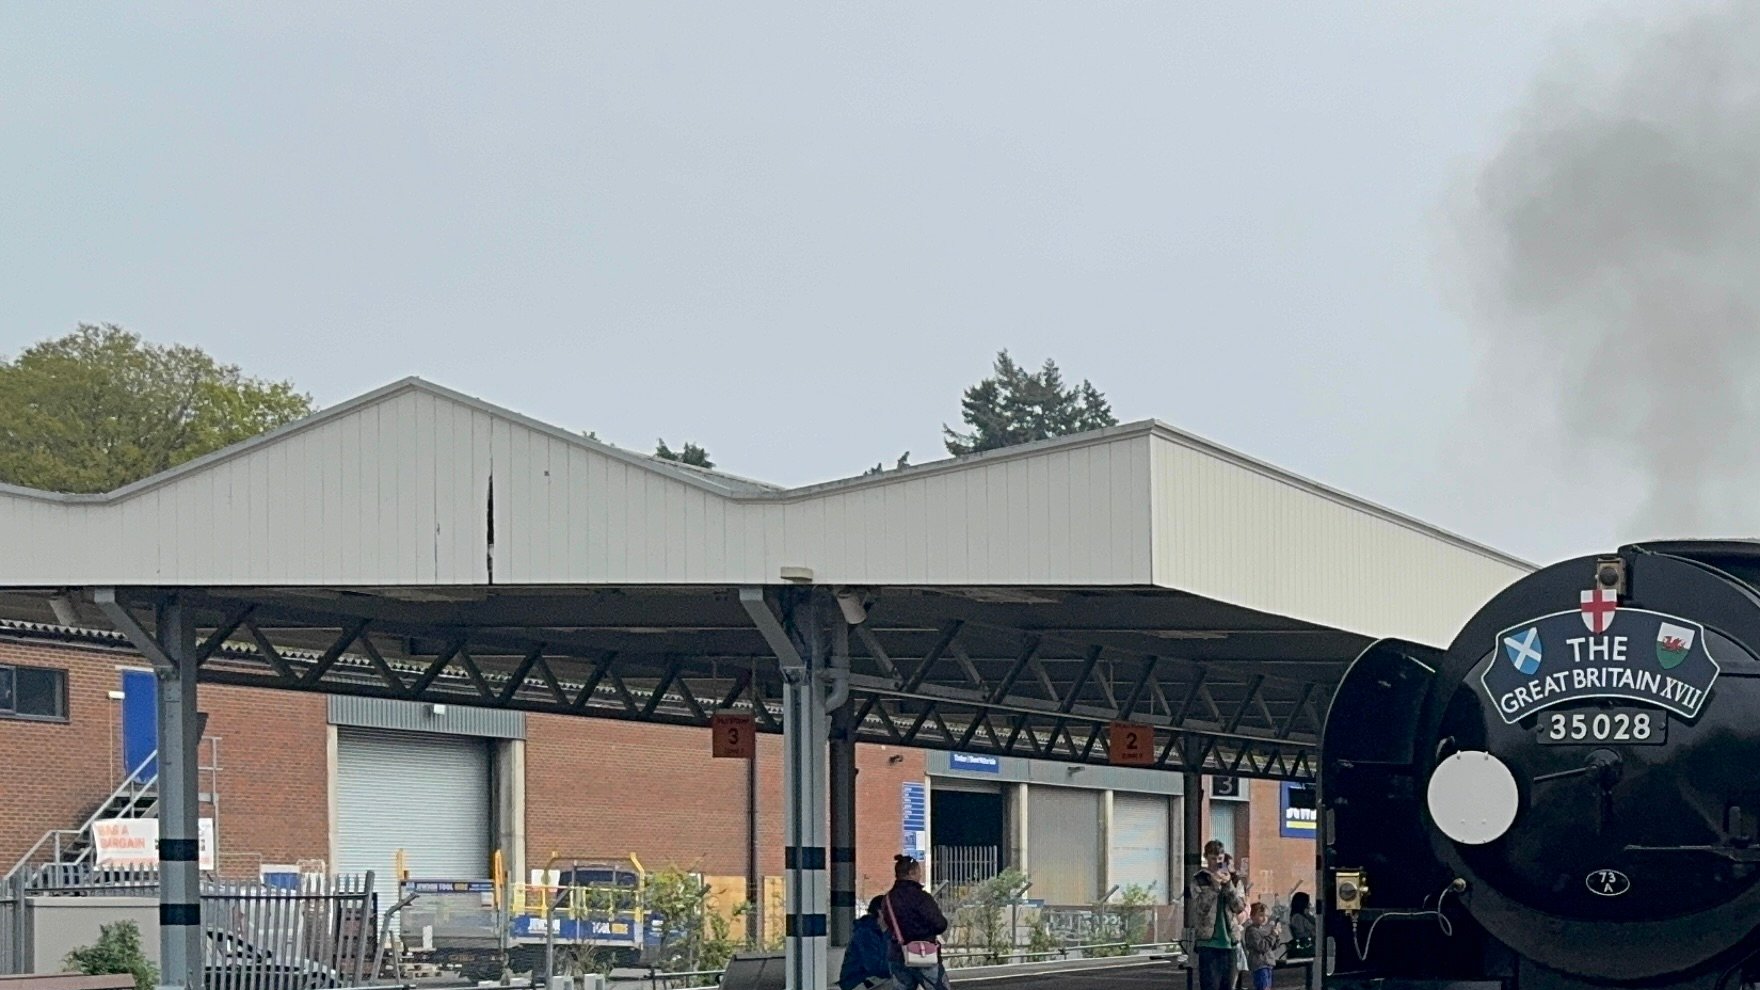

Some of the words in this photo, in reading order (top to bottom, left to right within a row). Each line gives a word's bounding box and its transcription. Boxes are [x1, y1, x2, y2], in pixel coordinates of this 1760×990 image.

[1566, 636, 1628, 662] THE
[1501, 671, 1569, 713] GREAT
[1572, 667, 1661, 694] BRITAIN
[1660, 676, 1702, 709] XVII
[1550, 713, 1651, 740] 35028
[728, 727, 739, 745] 3
[1126, 732, 1138, 750] 2
[1218, 776, 1233, 795] 3
[1598, 871, 1616, 883] 73
[1603, 882, 1614, 893] A
